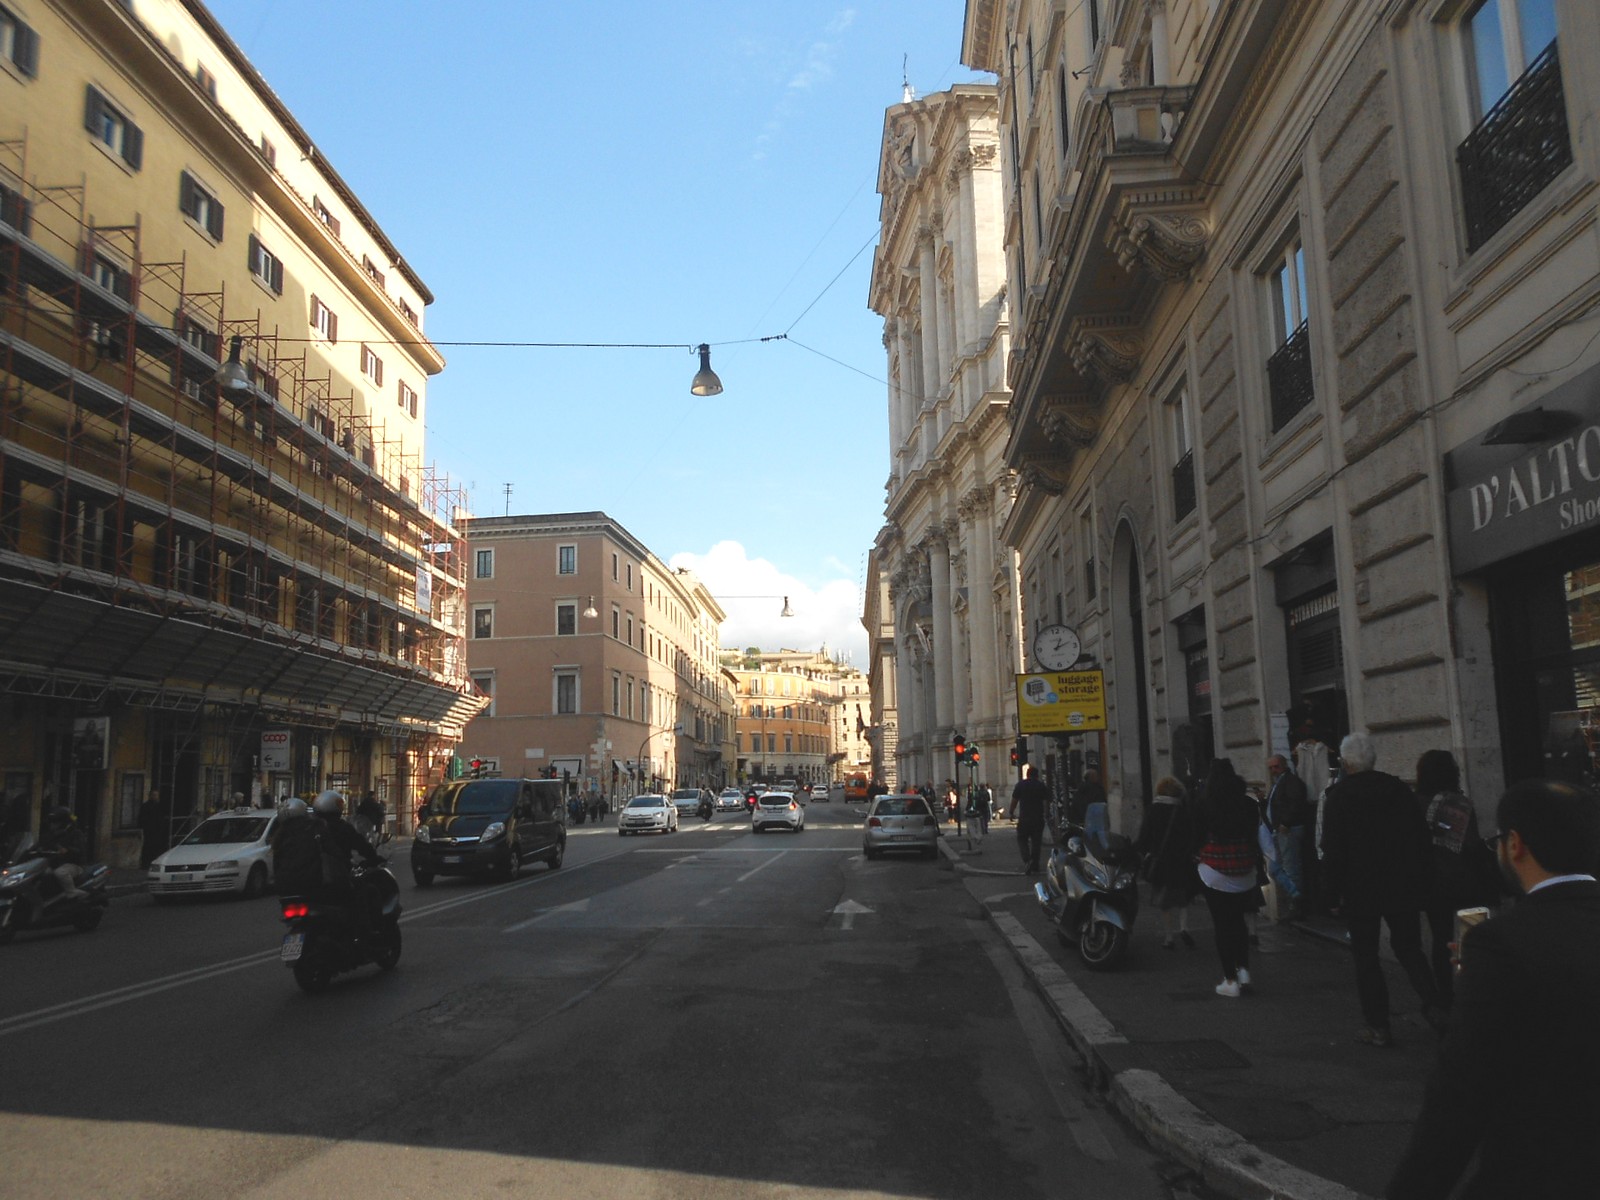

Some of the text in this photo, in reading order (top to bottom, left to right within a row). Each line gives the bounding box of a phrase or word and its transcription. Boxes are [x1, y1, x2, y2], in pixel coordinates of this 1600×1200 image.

[1058, 674, 1099, 686] luggage
[1058, 685, 1100, 695] storage
[263, 734, 287, 744] coop
